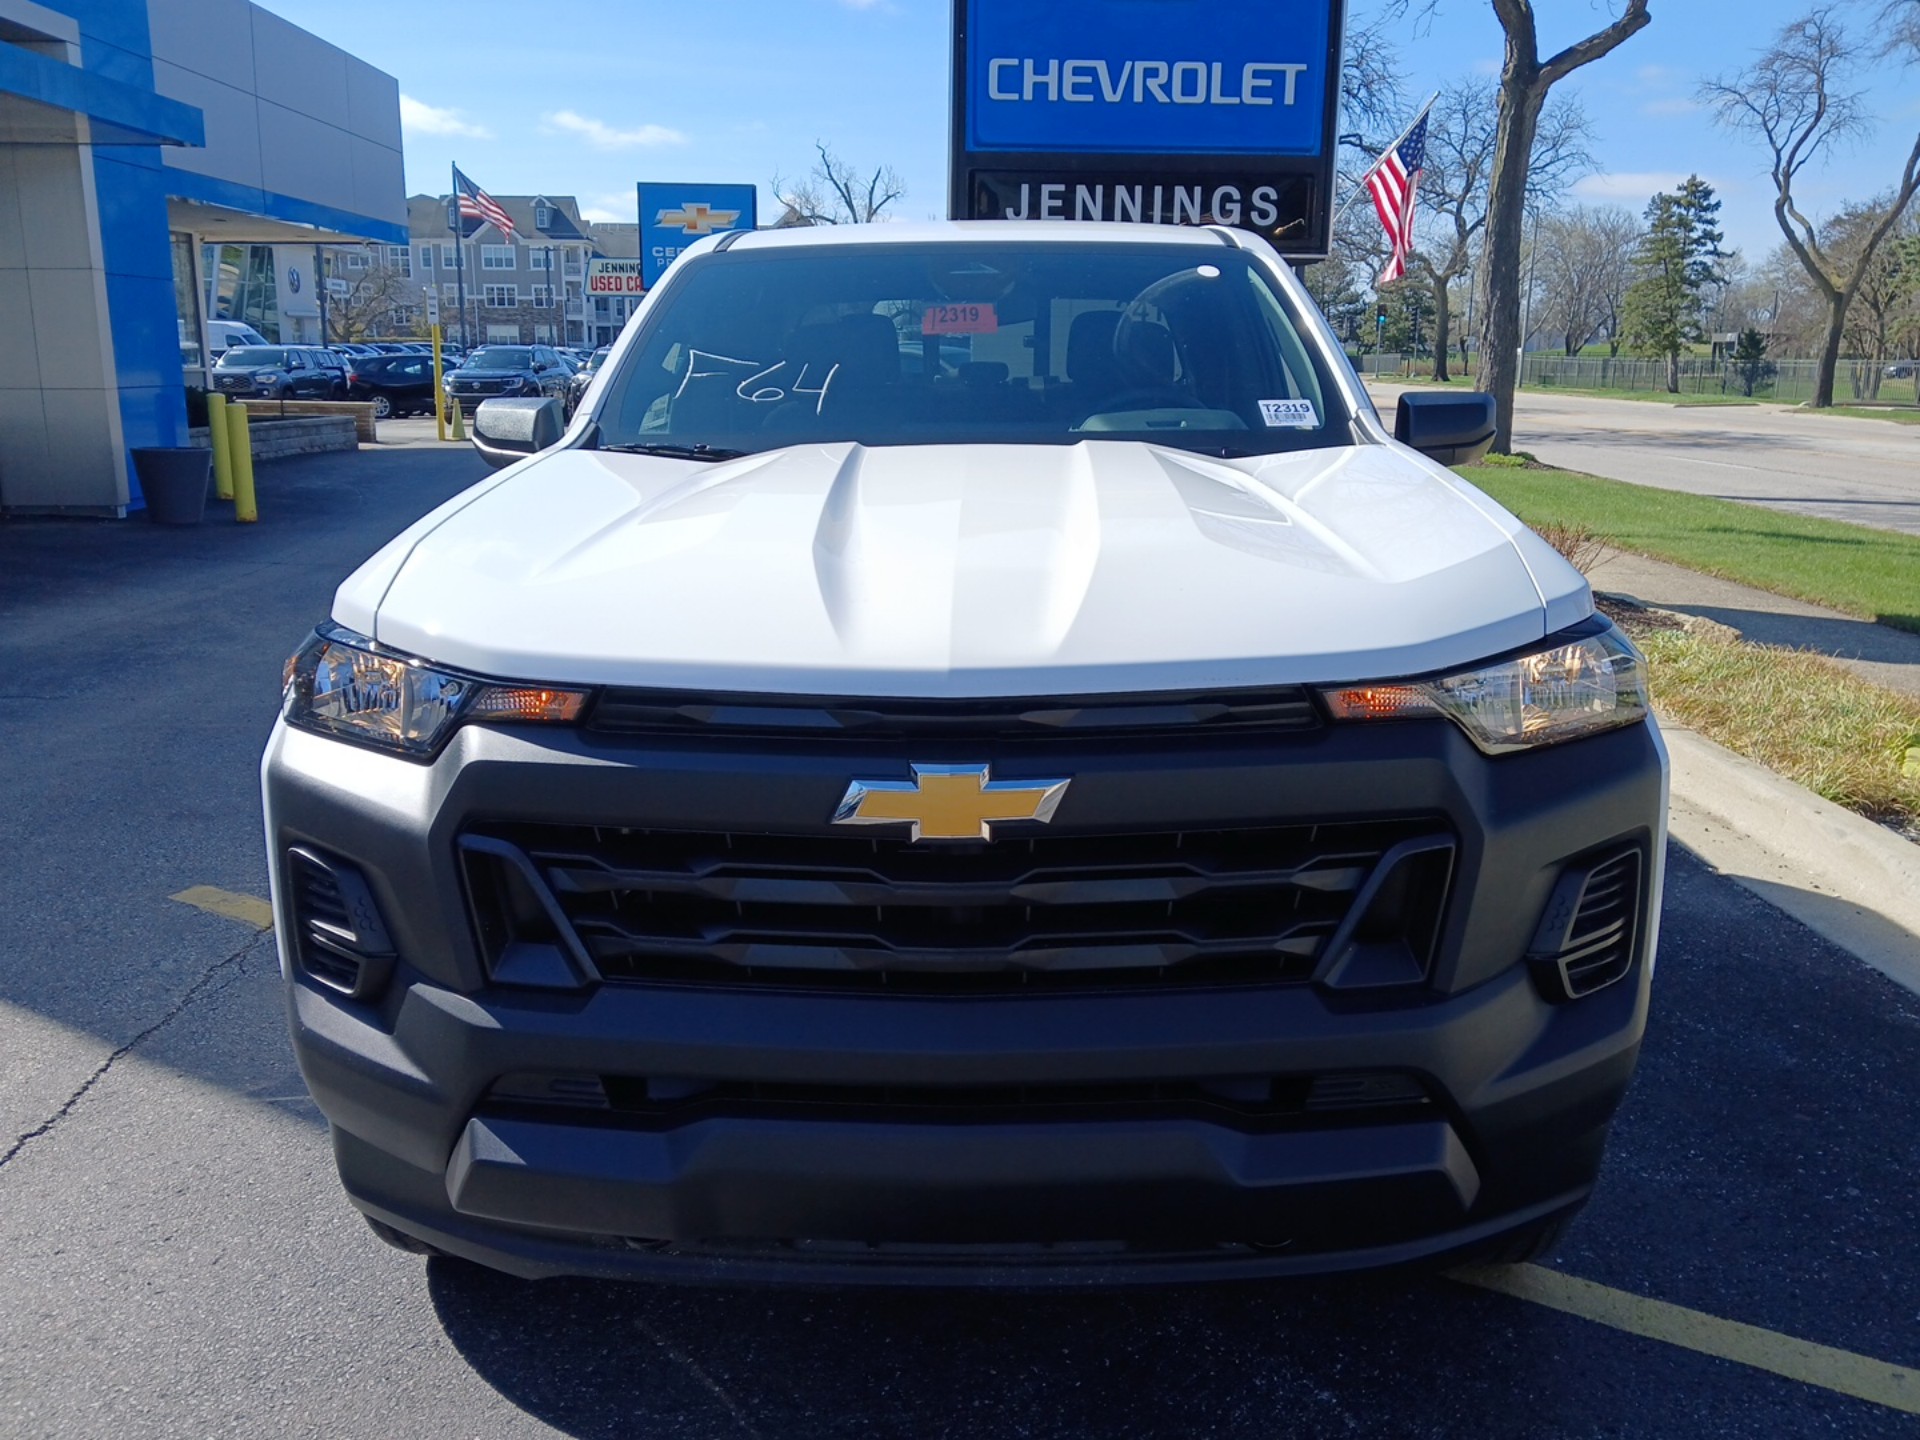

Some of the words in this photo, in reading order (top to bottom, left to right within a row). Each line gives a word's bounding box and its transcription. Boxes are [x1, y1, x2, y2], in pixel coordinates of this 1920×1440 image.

[988, 57, 1307, 105] CHEVROLET
[1005, 183, 1278, 226] JENNINGS
[591, 275, 622, 291] USED
[1262, 403, 1310, 413] T2319
